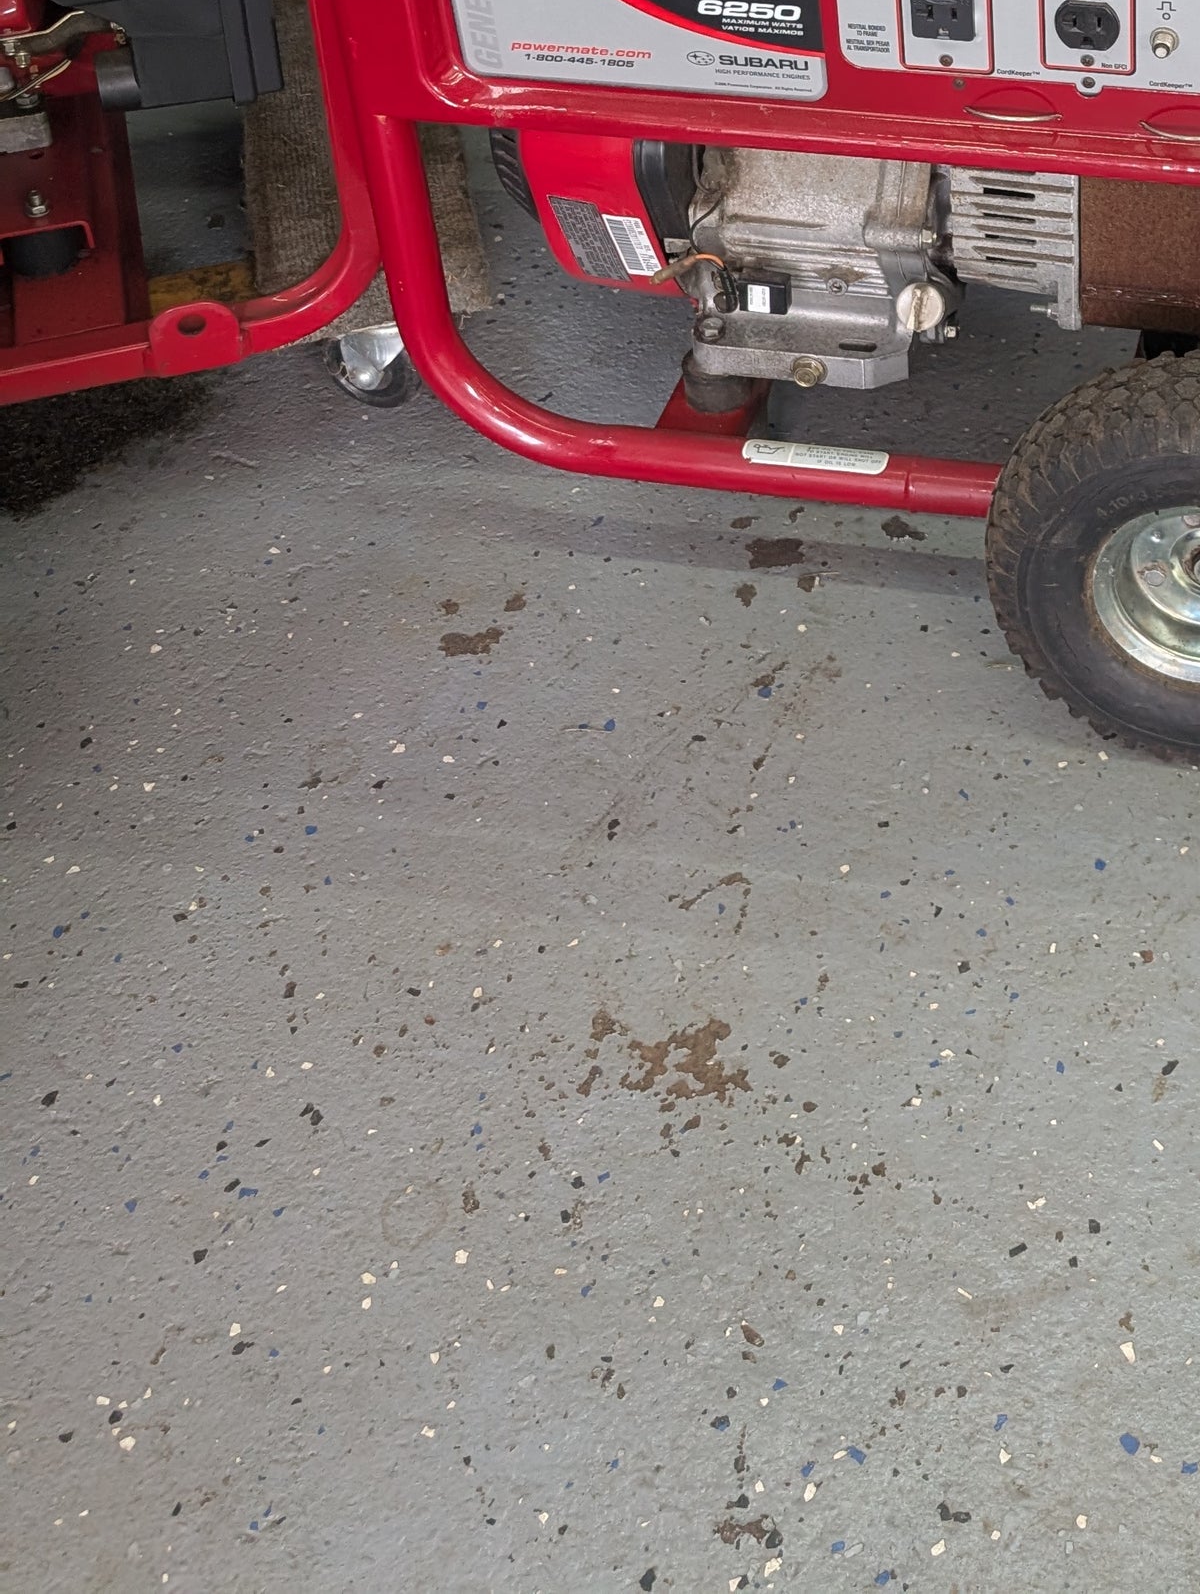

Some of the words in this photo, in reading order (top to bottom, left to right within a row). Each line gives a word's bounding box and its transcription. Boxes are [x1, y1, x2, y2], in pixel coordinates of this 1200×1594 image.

[697, 0, 802, 22] 6250
[721, 24, 755, 32] VATIOS
[758, 26, 804, 36] MÁXIMOS
[722, 18, 770, 26] MAXIMUM
[771, 21, 804, 29] WATTS
[510, 42, 652, 60] powermate.com
[524, 53, 635, 68] 1-800-445-1805
[718, 54, 809, 71] SUBARU
[732, 70, 780, 78] PERFORMANCE
